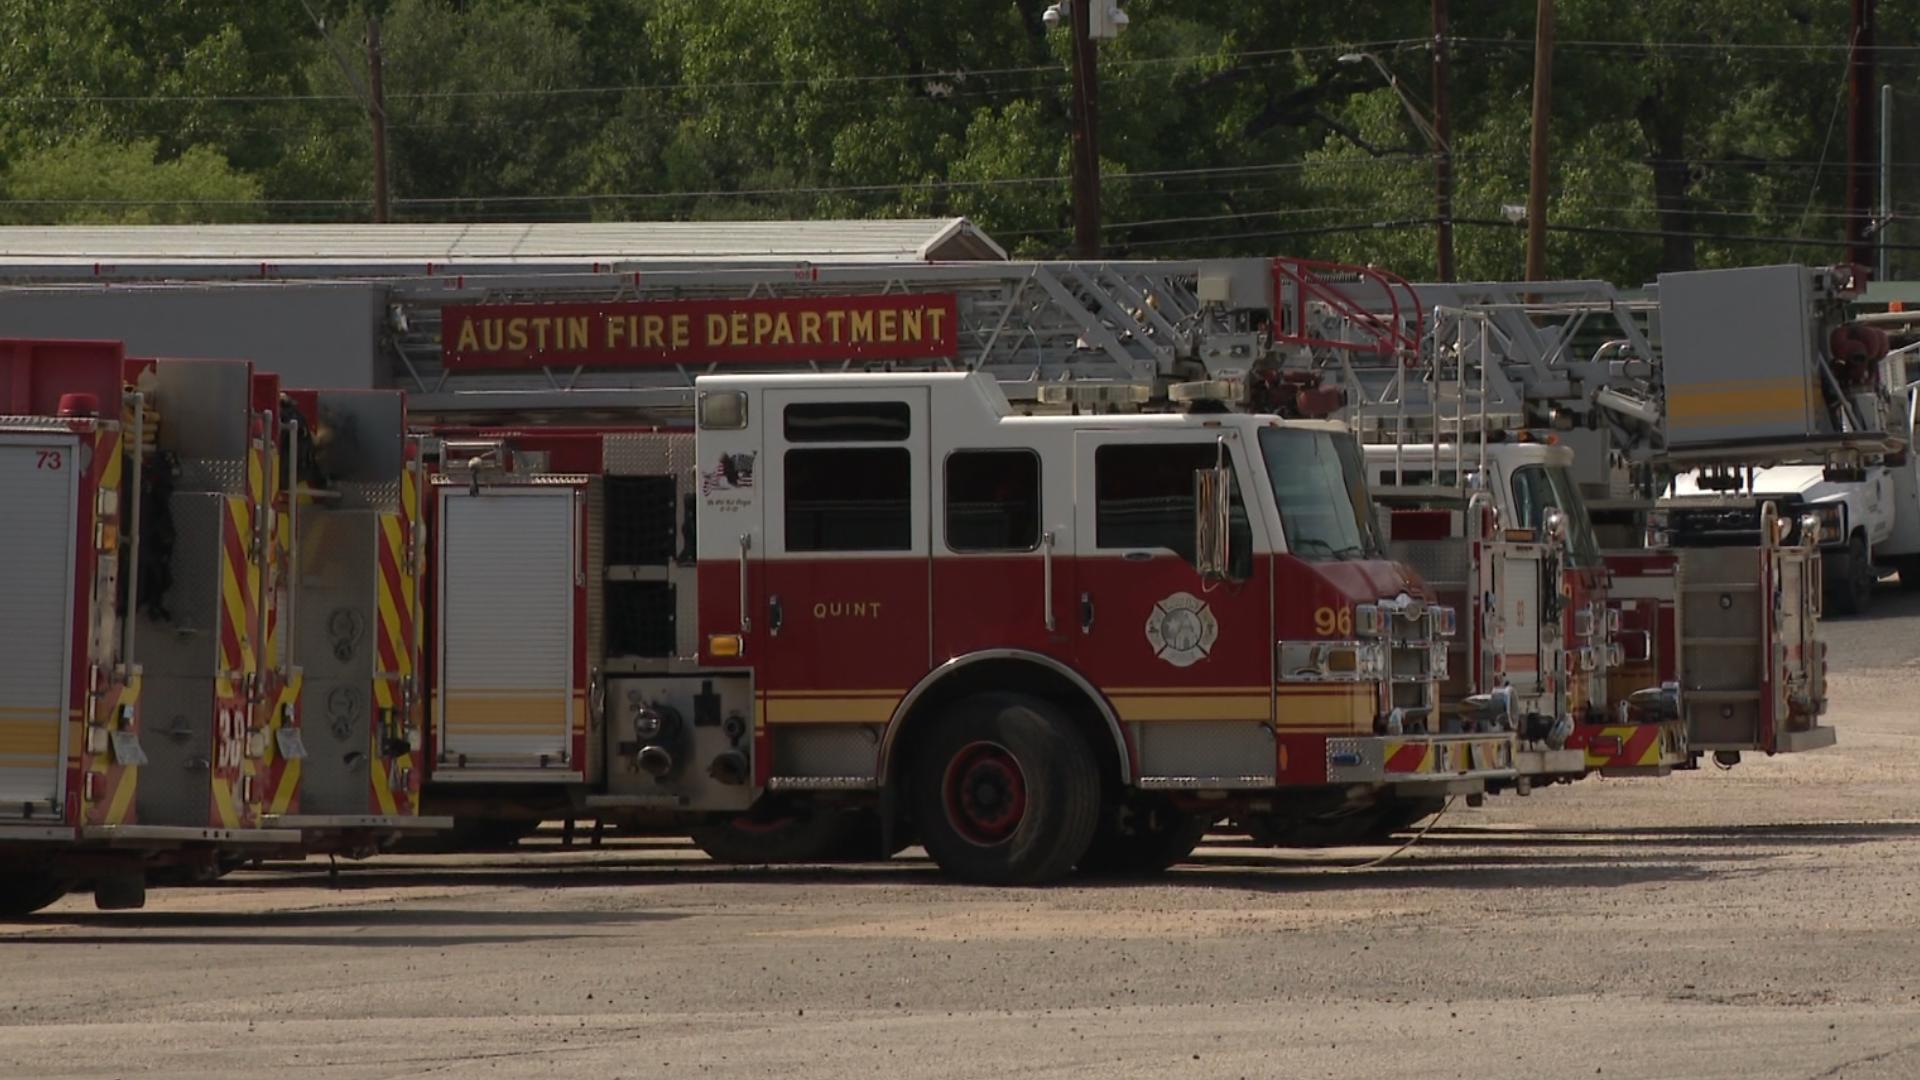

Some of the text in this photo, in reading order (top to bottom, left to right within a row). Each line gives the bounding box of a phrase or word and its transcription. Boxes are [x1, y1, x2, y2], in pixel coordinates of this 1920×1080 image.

[456, 308, 947, 352] AUSTIN FIRE DEPARTMENT
[36, 451, 61, 470] 73
[814, 602, 882, 619] QUINT
[1314, 606, 1352, 636] 96
